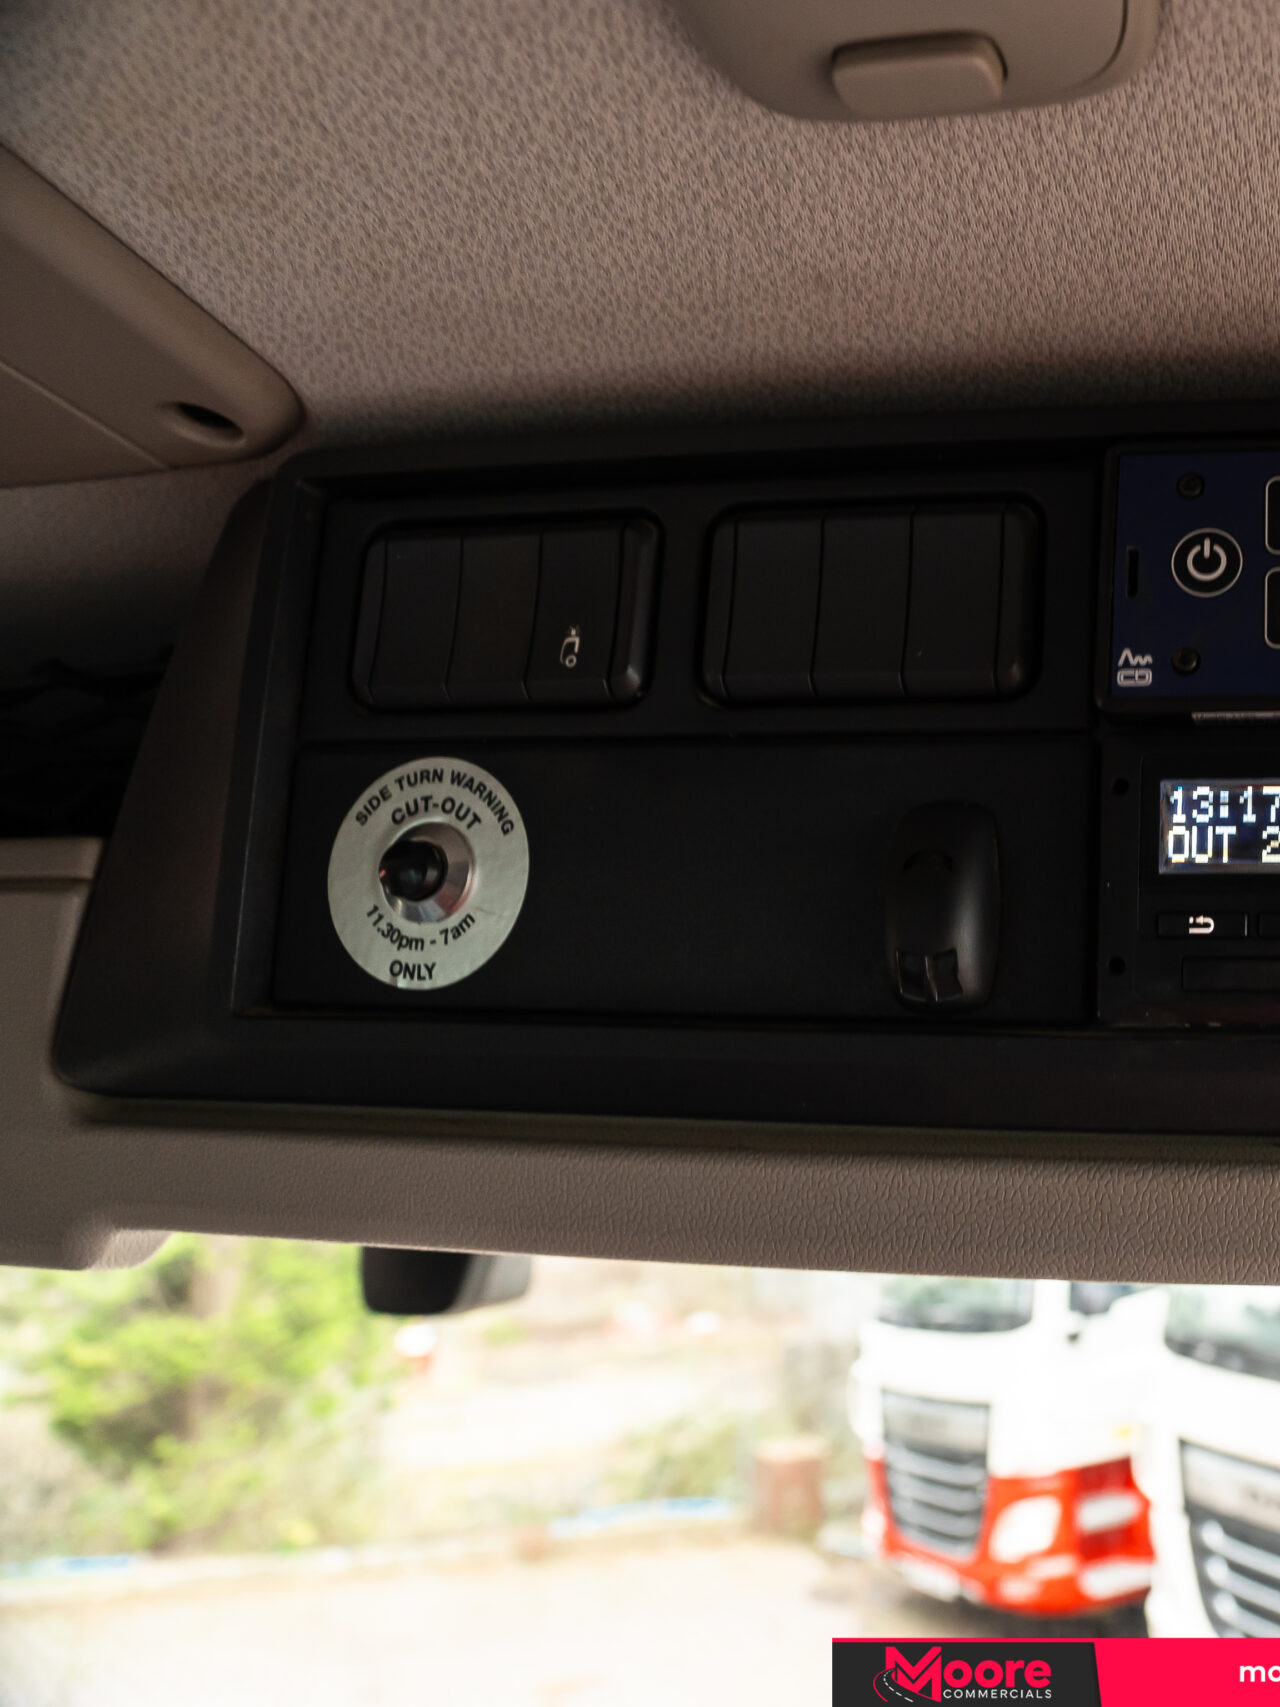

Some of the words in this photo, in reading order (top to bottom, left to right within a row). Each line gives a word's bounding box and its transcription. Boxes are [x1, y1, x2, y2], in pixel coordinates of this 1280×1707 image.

[355, 785, 393, 827] SIDE
[394, 768, 444, 792] TURN
[450, 769, 515, 836] WARNING
[391, 795, 482, 830] CUT-OUT
[1168, 825, 1237, 863] OUT
[366, 904, 425, 951] 11.30pm
[439, 912, 476, 946] 7am
[389, 959, 437, 981] ONLY
